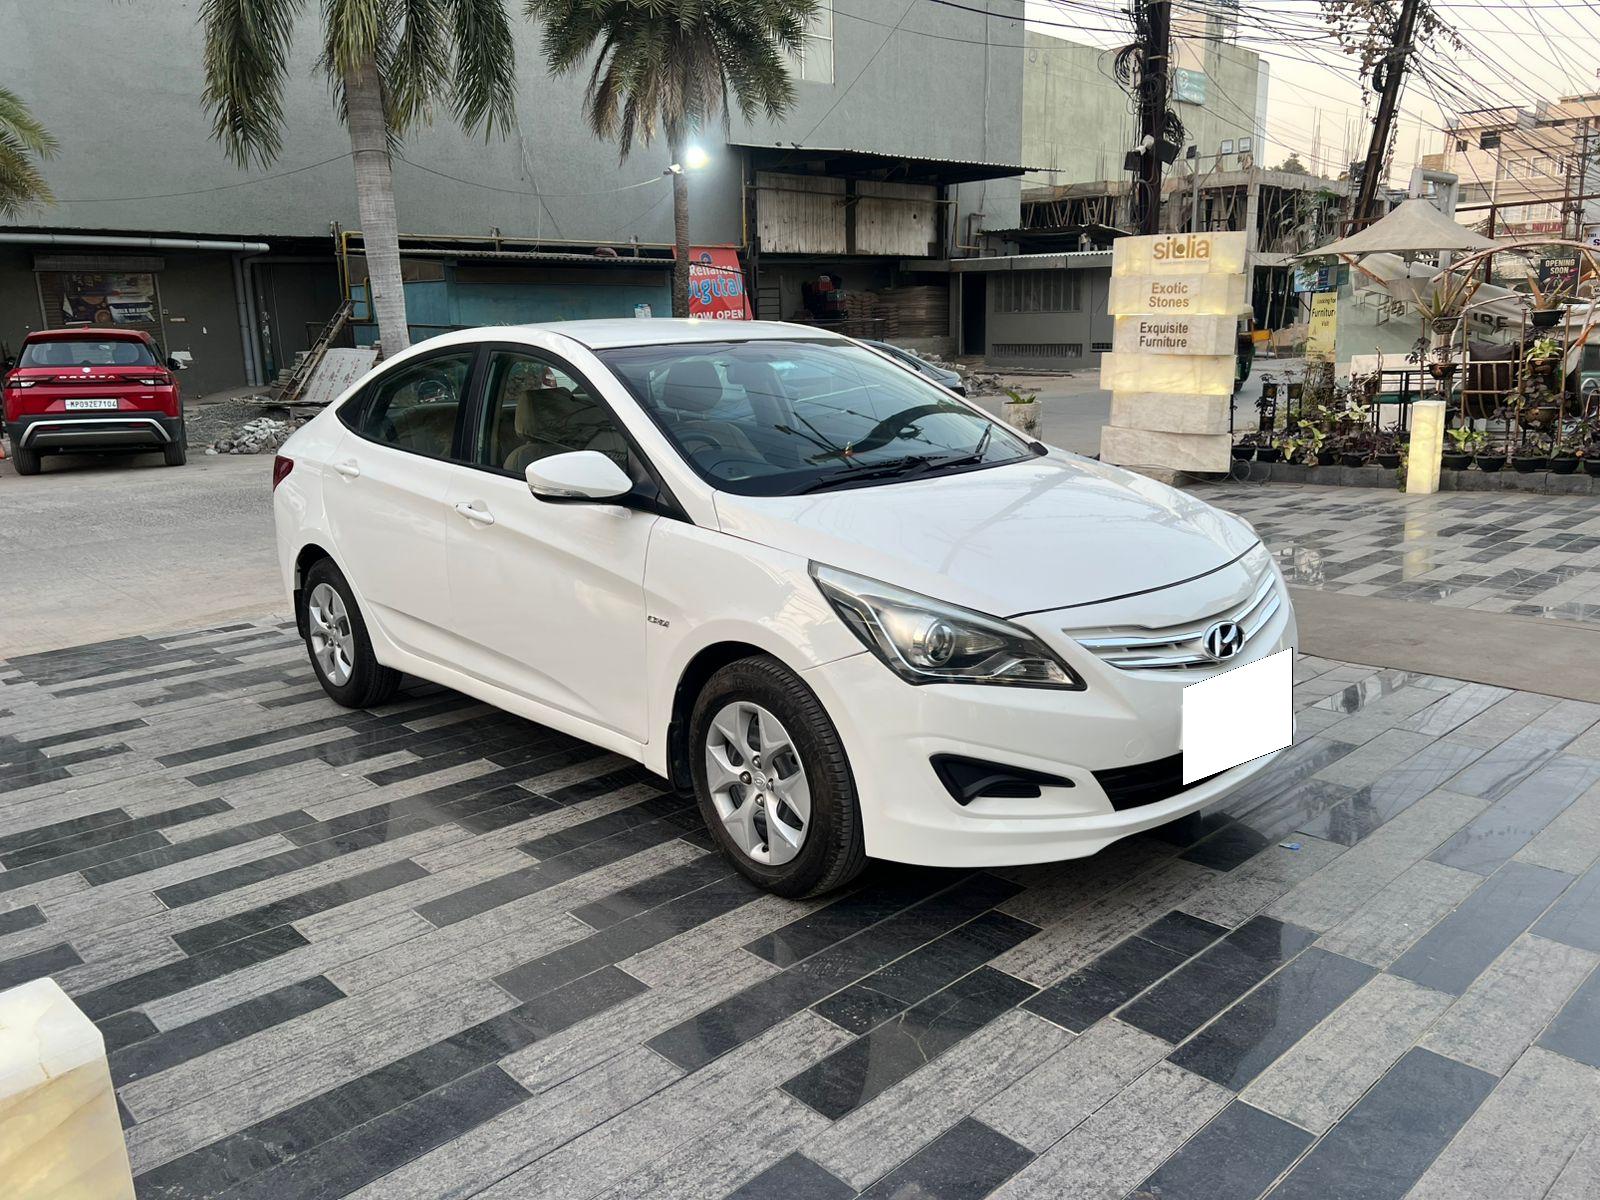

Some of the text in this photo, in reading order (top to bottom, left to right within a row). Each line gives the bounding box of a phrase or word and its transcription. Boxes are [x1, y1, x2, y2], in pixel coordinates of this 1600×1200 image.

[1545, 259, 1575, 267] OPENING
[1550, 266, 1569, 275] SOON
[688, 269, 743, 305] igital
[1151, 282, 1188, 294] Exotic
[1149, 296, 1189, 308] Stones
[716, 309, 744, 319] OPEN
[1140, 322, 1189, 336] Exquisite
[1139, 335, 1187, 348] Furniture
